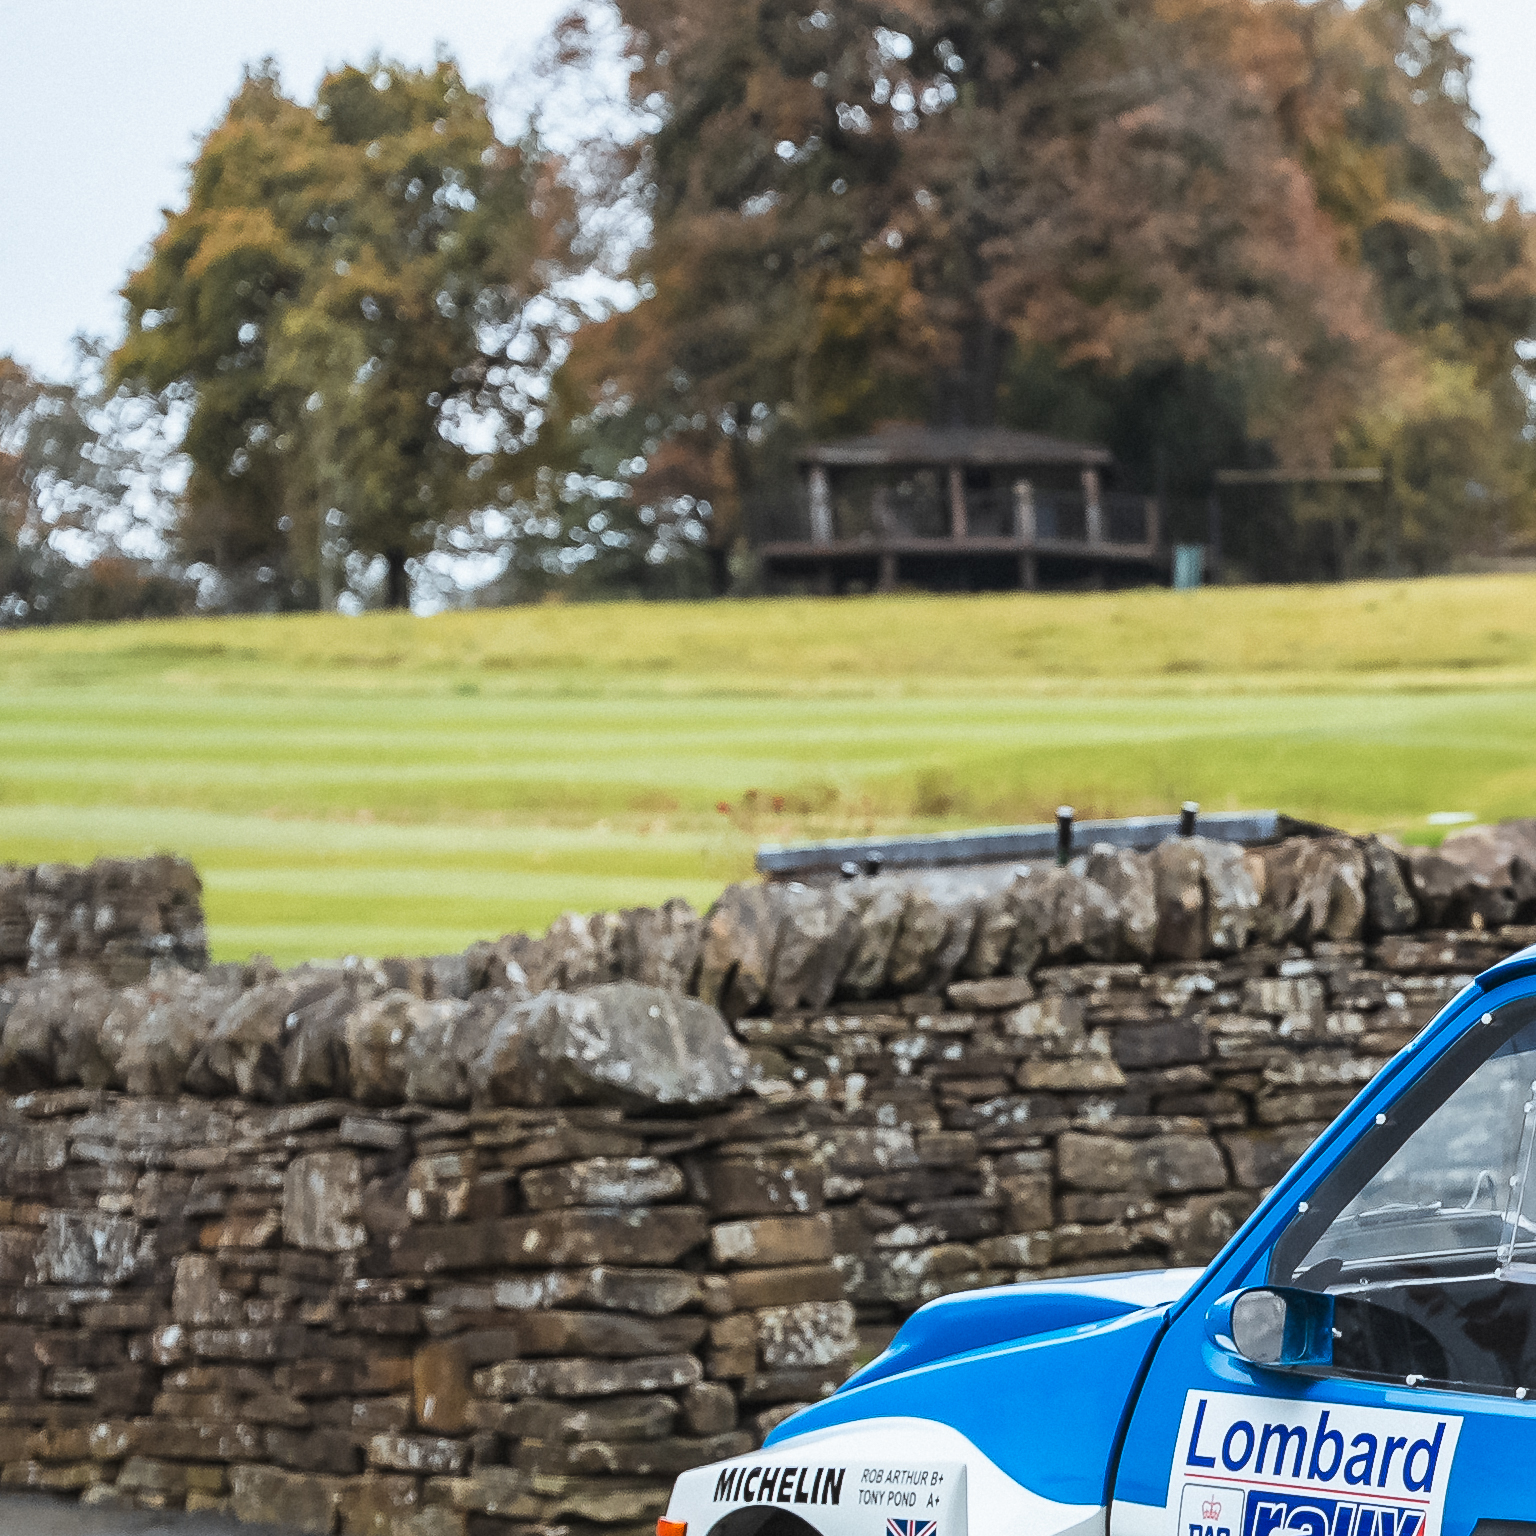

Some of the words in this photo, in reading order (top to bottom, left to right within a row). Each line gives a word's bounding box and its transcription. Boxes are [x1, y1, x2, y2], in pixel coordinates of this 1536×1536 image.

[1186, 1399, 1446, 1493] Lombard
[713, 1466, 846, 1505] MICHELIN
[860, 1469, 883, 1484] ROB
[885, 1470, 929, 1485] ARTHUR
[930, 1471, 944, 1486] B+
[858, 1489, 885, 1506] TONY
[887, 1491, 916, 1507] POND
[926, 1493, 940, 1508] A+
